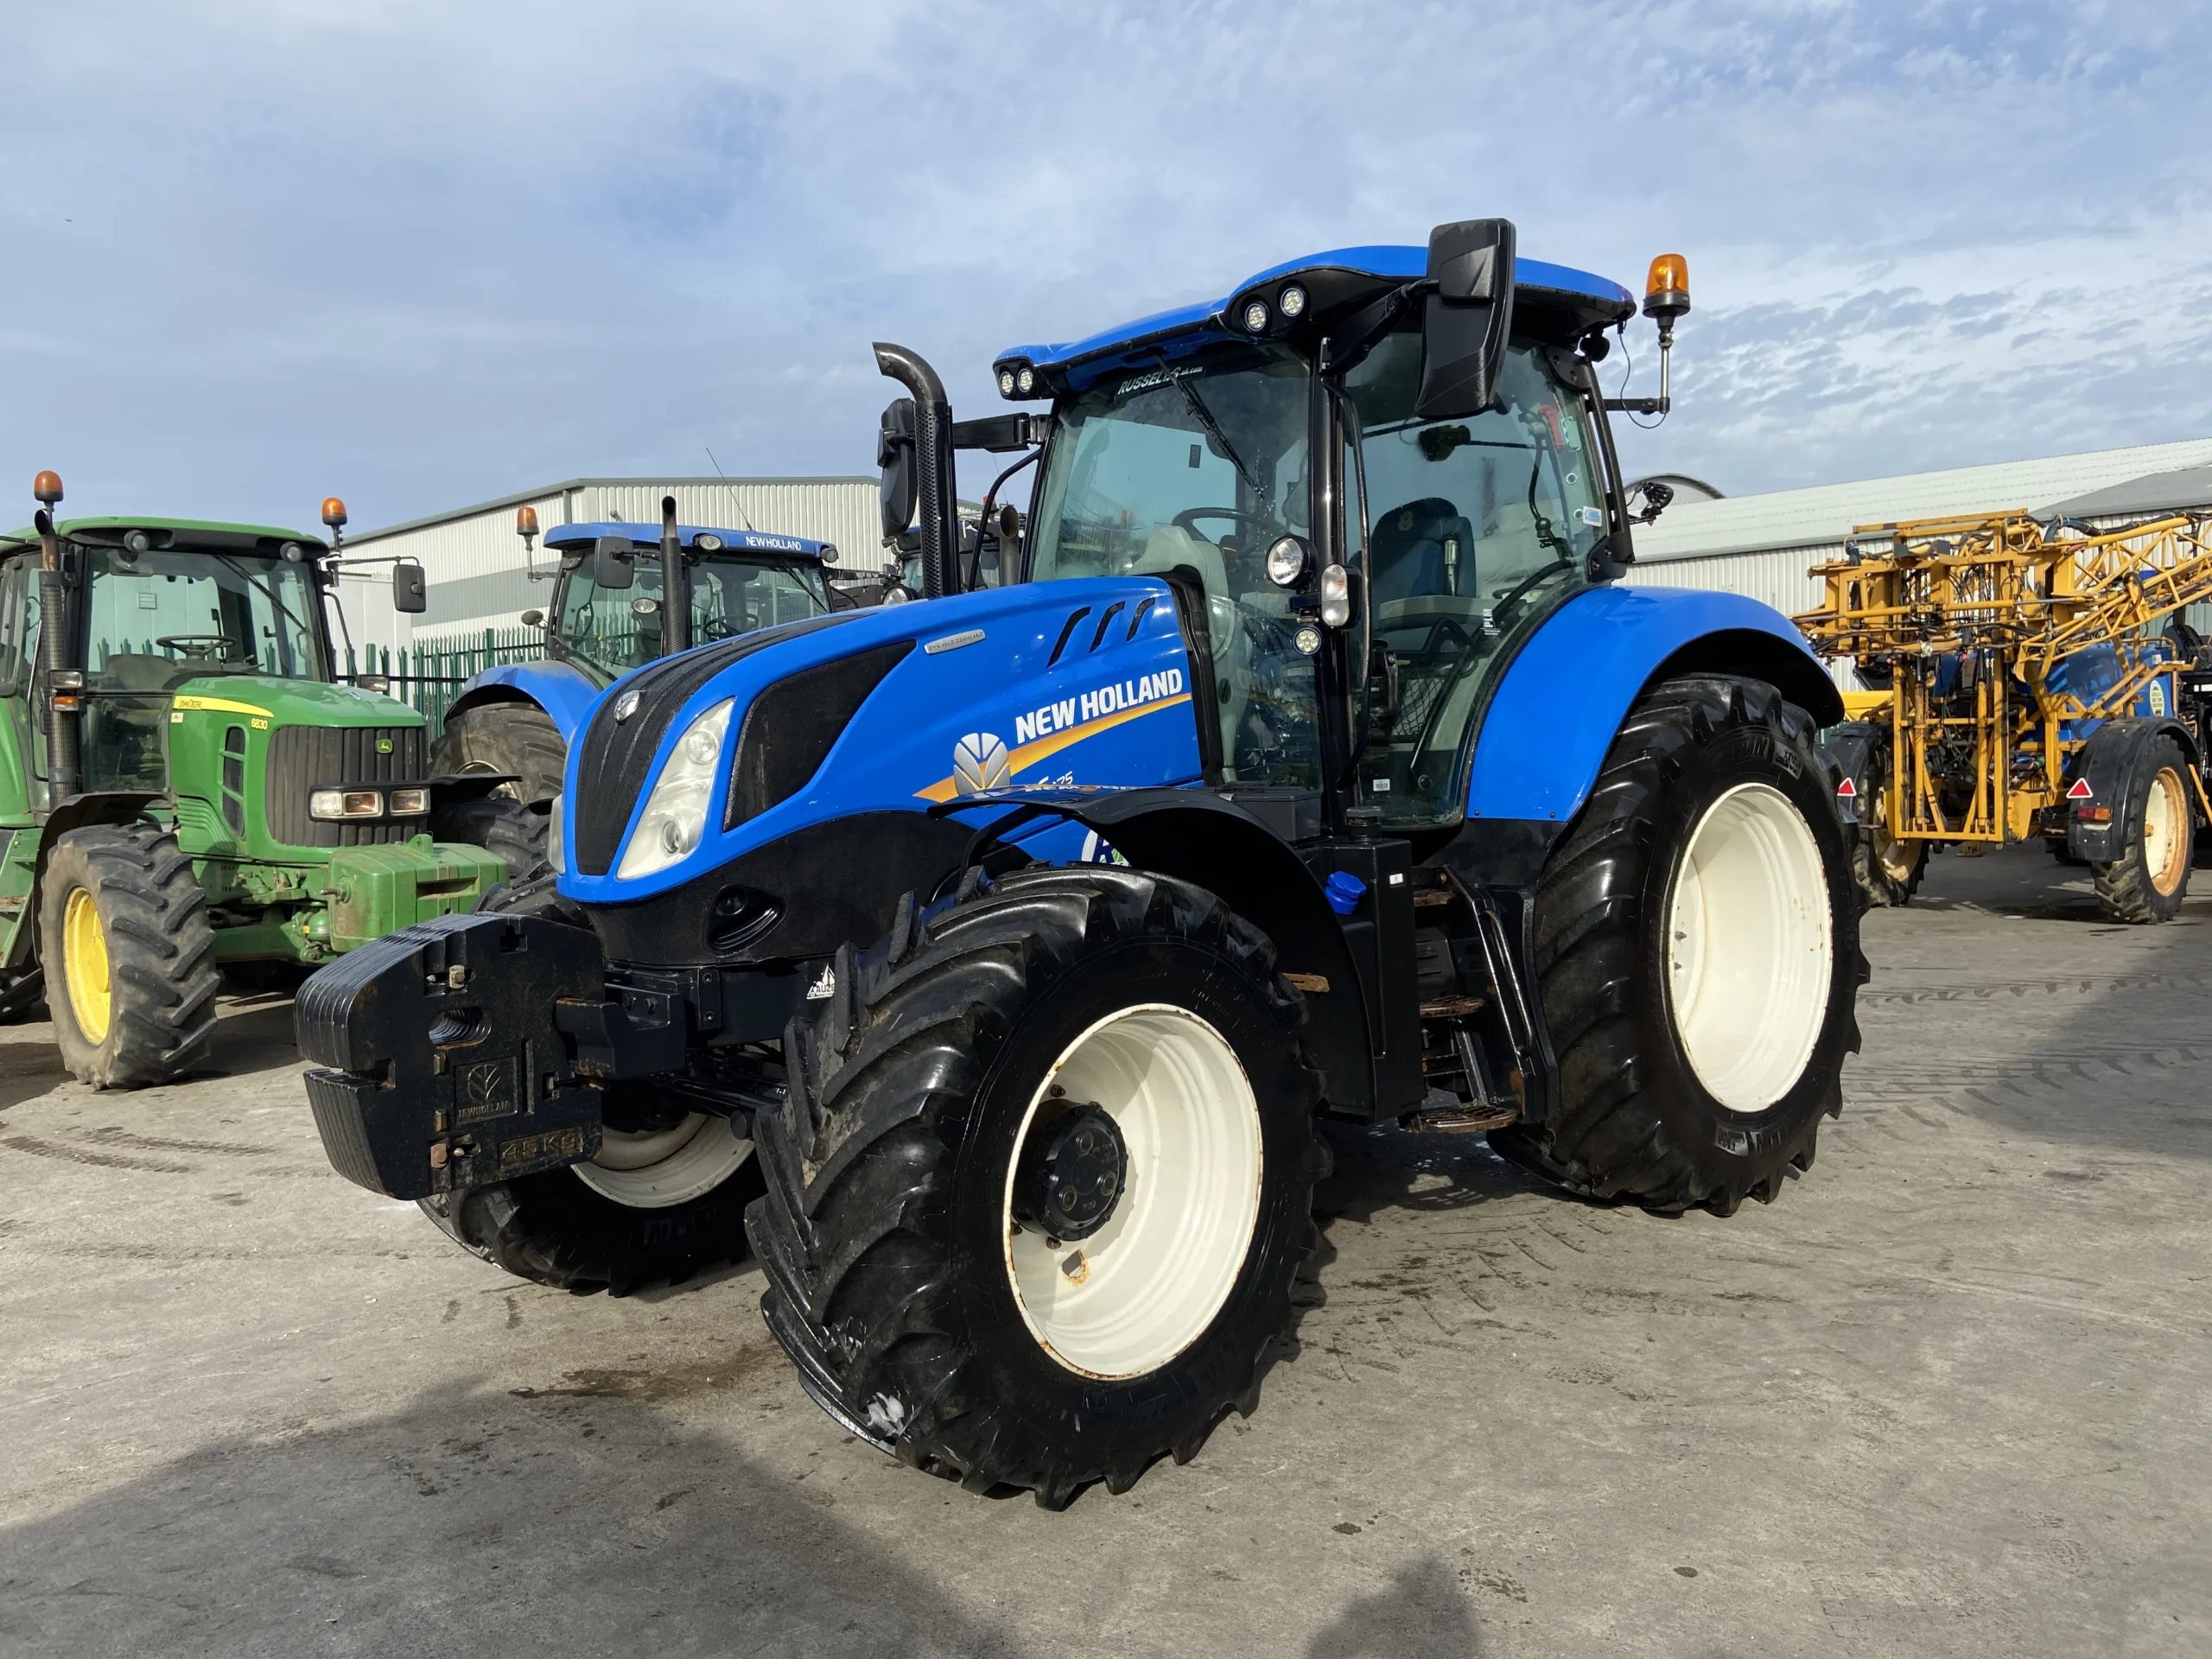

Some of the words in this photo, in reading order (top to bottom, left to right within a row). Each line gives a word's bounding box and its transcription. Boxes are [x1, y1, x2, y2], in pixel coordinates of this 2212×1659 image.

[746, 536, 766, 546] NEW
[766, 537, 802, 550] HOLLAND
[1015, 697, 1076, 744] NEW
[1080, 668, 1183, 721] HOLLAND
[251, 717, 268, 730] 6830
